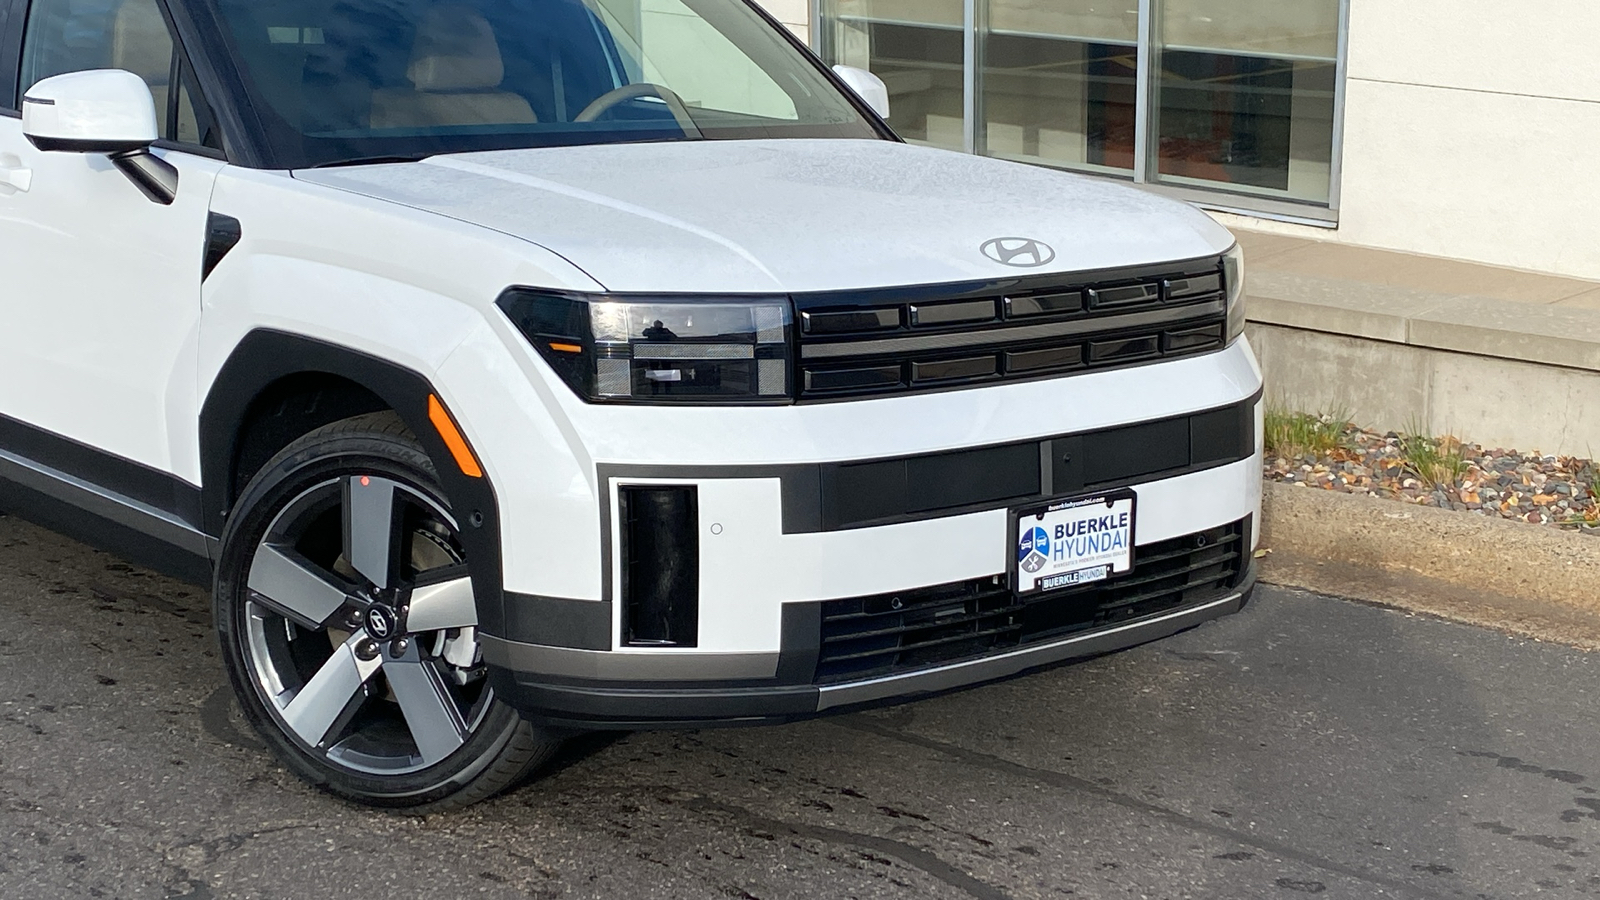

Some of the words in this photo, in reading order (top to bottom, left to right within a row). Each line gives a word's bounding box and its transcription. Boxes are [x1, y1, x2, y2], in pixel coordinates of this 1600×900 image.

[1054, 512, 1128, 540] BUERKLE
[1053, 528, 1127, 562] HYUNDAI
[1043, 574, 1079, 588] BUERKLE
